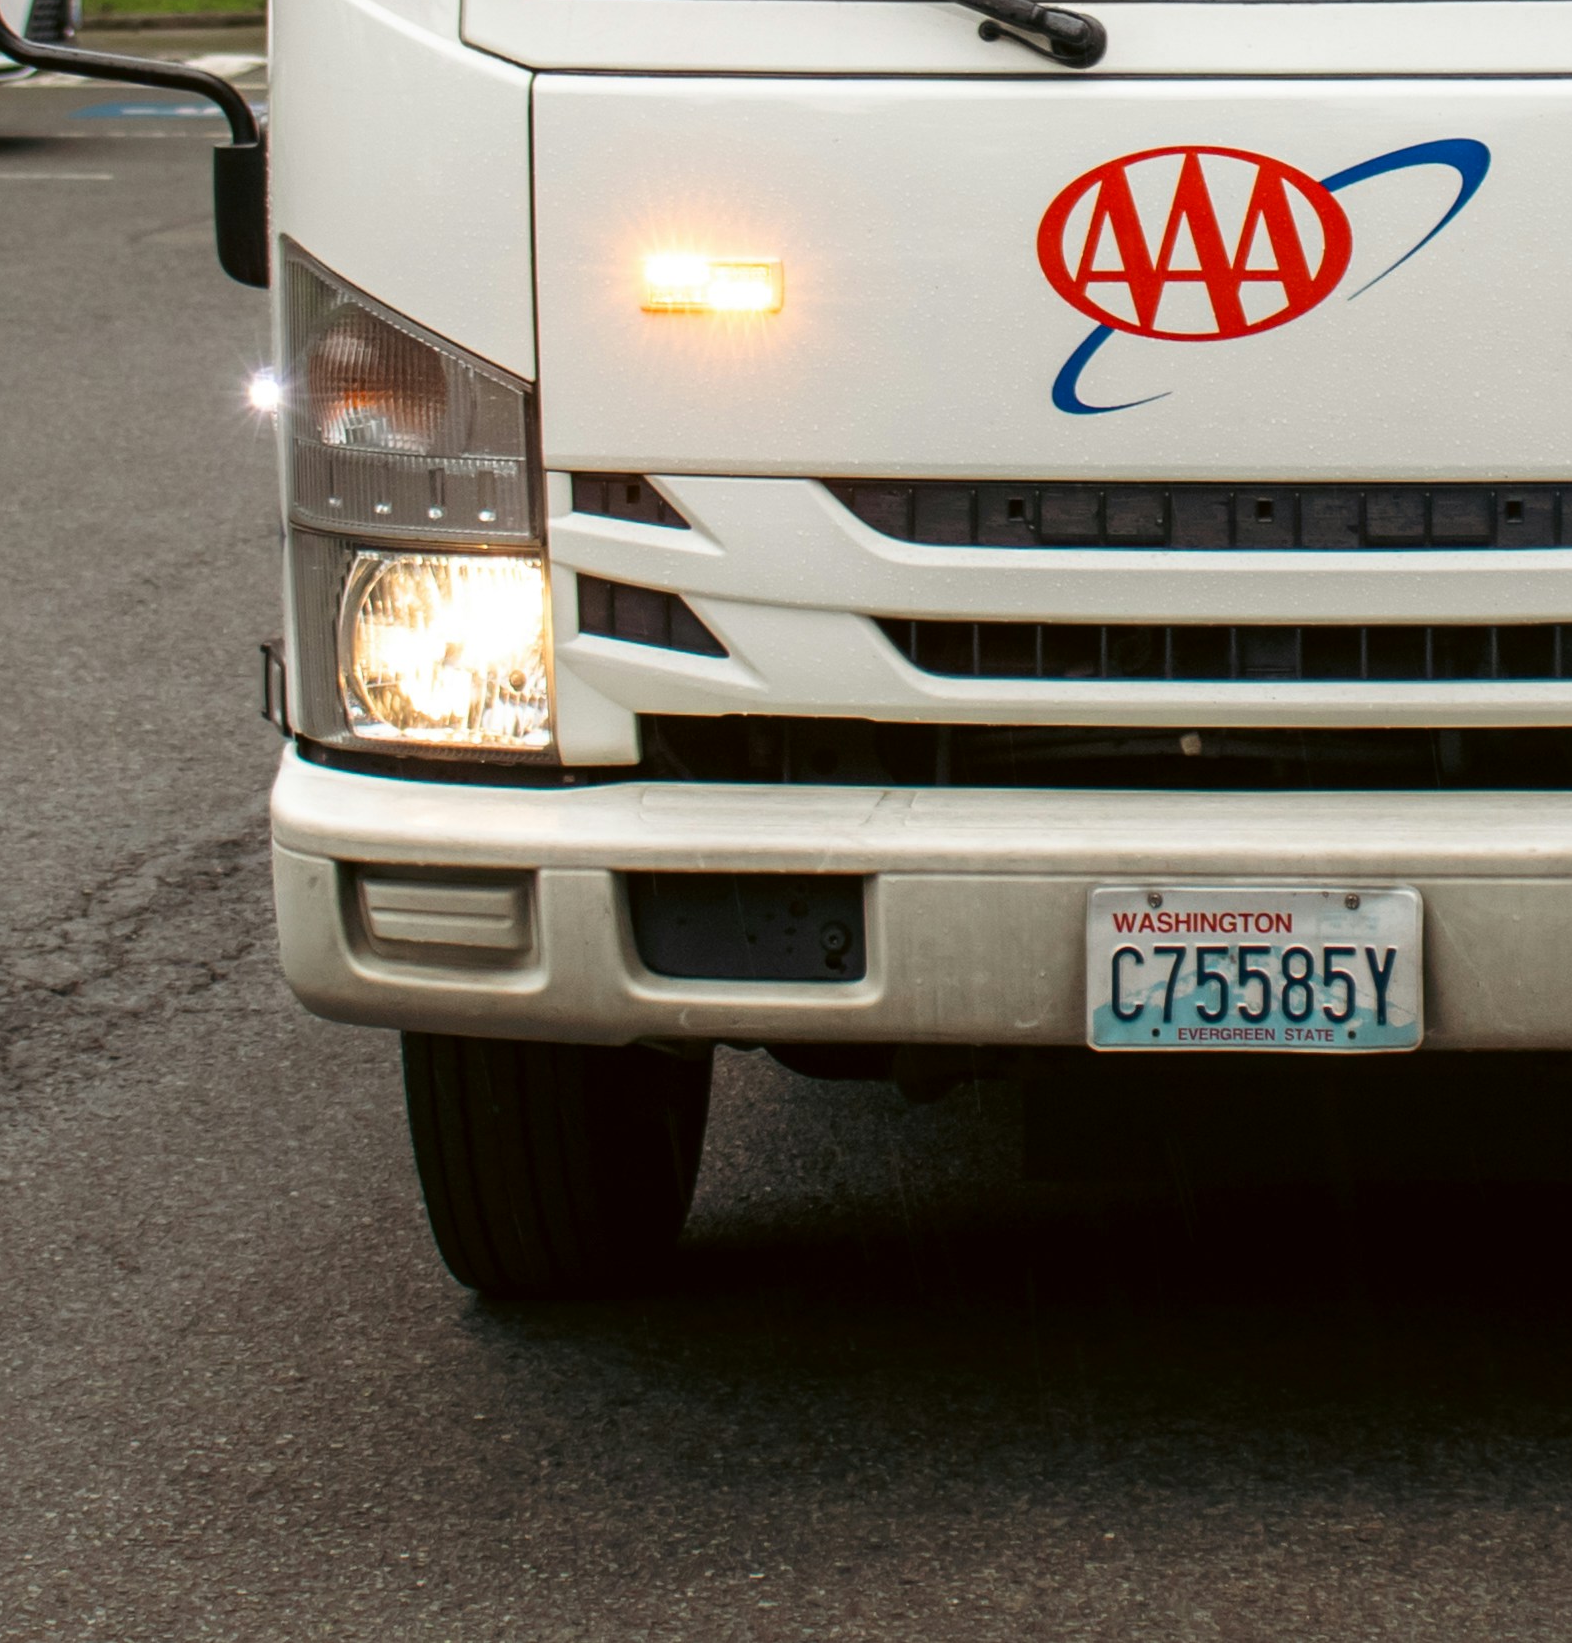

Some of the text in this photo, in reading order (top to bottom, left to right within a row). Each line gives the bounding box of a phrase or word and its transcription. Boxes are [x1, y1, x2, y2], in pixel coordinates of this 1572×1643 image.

[1059, 146, 1331, 339] AAA
[1112, 912, 1293, 933] WASHINGTON
[1111, 944, 1398, 1026] C75585Y
[1178, 1028, 1335, 1043] EVERGREEN STATE
